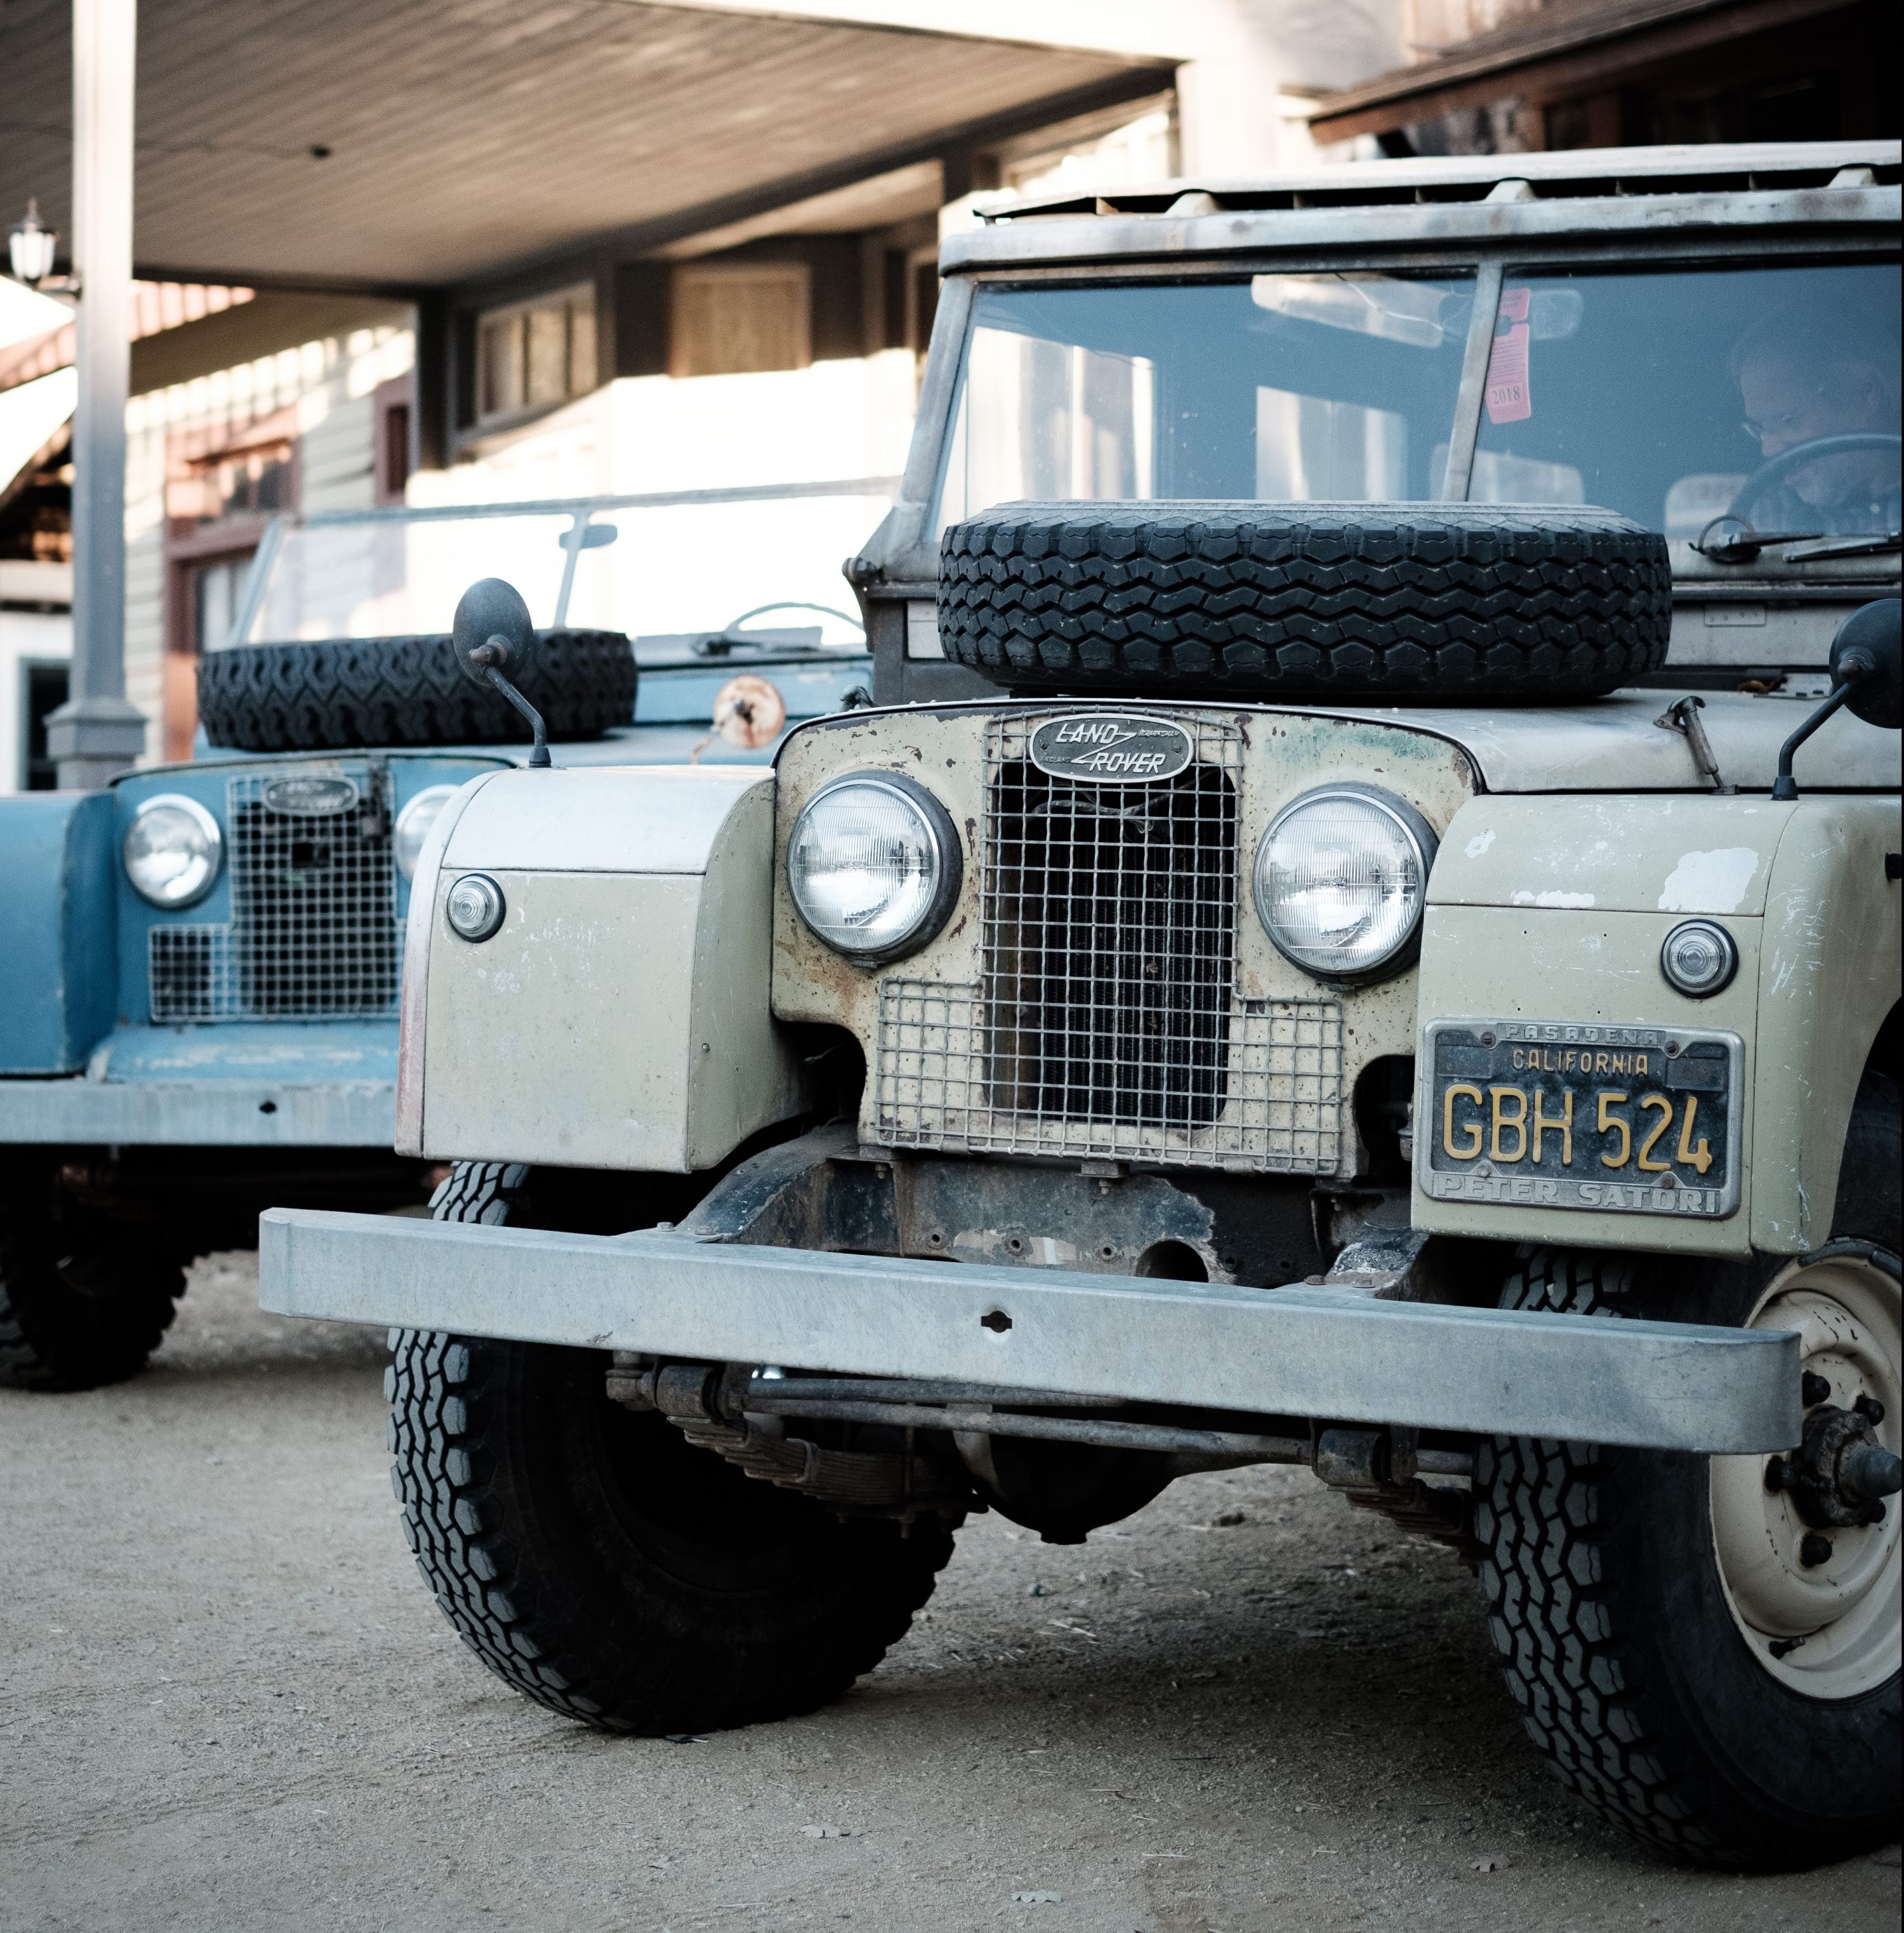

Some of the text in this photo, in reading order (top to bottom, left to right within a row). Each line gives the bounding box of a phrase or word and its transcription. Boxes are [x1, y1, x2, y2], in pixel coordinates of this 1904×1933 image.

[1492, 386, 1521, 405] 2018
[1055, 723, 1119, 744] LAND
[1089, 752, 1166, 774] ROVER
[1505, 1025, 1659, 1046] PASADENA
[1512, 1048, 1649, 1076] CALIFORNIA
[1443, 1084, 1713, 1174] GBH 524
[1436, 1176, 1721, 1214] PETER SATORI
